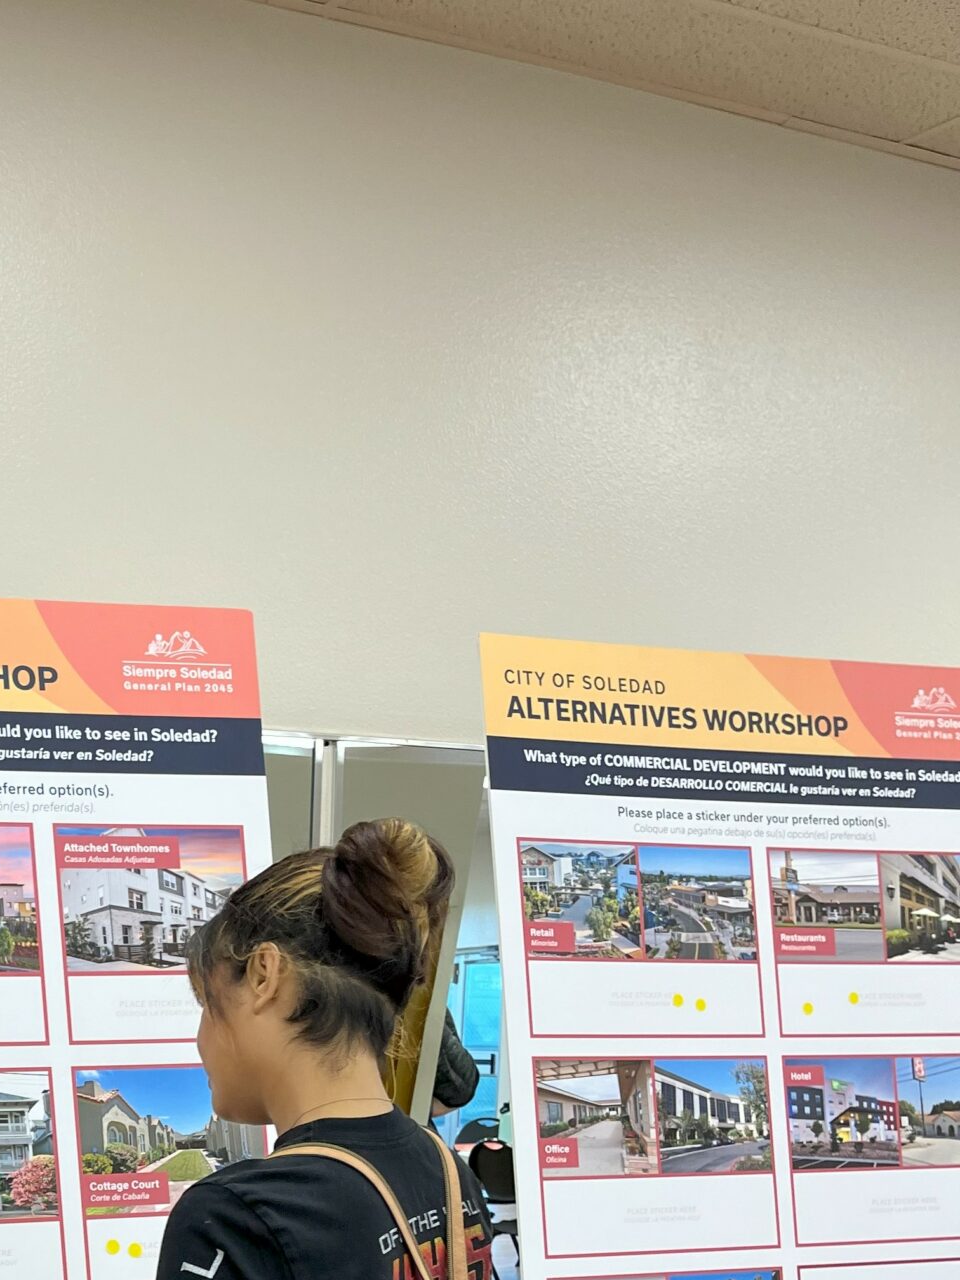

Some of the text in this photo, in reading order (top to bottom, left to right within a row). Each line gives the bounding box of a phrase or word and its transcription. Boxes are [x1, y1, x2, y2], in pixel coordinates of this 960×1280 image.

[122, 665, 232, 680] Siempre Soledad
[123, 681, 234, 693] General Plan 2045
[504, 669, 666, 695] CITY OF SOLEDAD
[507, 695, 849, 738] ALTERNATIVES WORKSHOP
[895, 716, 935, 728] Siempre
[24, 728, 52, 742] you
[55, 726, 82, 741] like
[85, 729, 101, 741] to
[104, 731, 131, 742] see
[134, 729, 148, 742] in
[151, 729, 218, 744] Soledad?
[896, 729, 932, 738] General
[934, 731, 953, 740] Plan
[53, 751, 73, 761] ver
[76, 752, 92, 761] en
[95, 749, 154, 763] Soledad?
[523, 748, 557, 765] What
[560, 752, 587, 767] type
[589, 754, 602, 766] of
[604, 754, 691, 772] COMMERCIAL
[693, 760, 787, 776] DEVELOPMENT
[788, 765, 824, 778] would
[825, 769, 846, 781] you
[848, 766, 868, 780] like
[870, 769, 882, 780] to
[884, 770, 903, 781] see
[905, 769, 916, 781] in
[49, 784, 114, 799] option(s).
[585, 773, 917, 799] ¿Qué tipo de DESARROLLO COMERCIAL le gustaría ver en Soledad?
[32, 801, 96, 815] preferida(s).
[618, 806, 891, 829] Please place a sticker under your preferred option(s).
[633, 823, 669, 836] Coloque
[670, 826, 686, 834] una
[688, 827, 723, 838] pegatina
[725, 828, 752, 839] debajo
[754, 829, 765, 838] de
[64, 843, 171, 854] Attached Townhomes
[64, 855, 156, 865] Casas Adosadas Adjuntas
[530, 928, 554, 937] Retail
[780, 933, 827, 943] Restaurants
[790, 1071, 812, 1081] Hotel
[544, 1144, 570, 1154] Office
[89, 1179, 160, 1193] Cottage Court
[90, 1194, 110, 1202] Corte
[123, 1192, 150, 1201] Cabaña
[408, 1209, 440, 1235] THE
